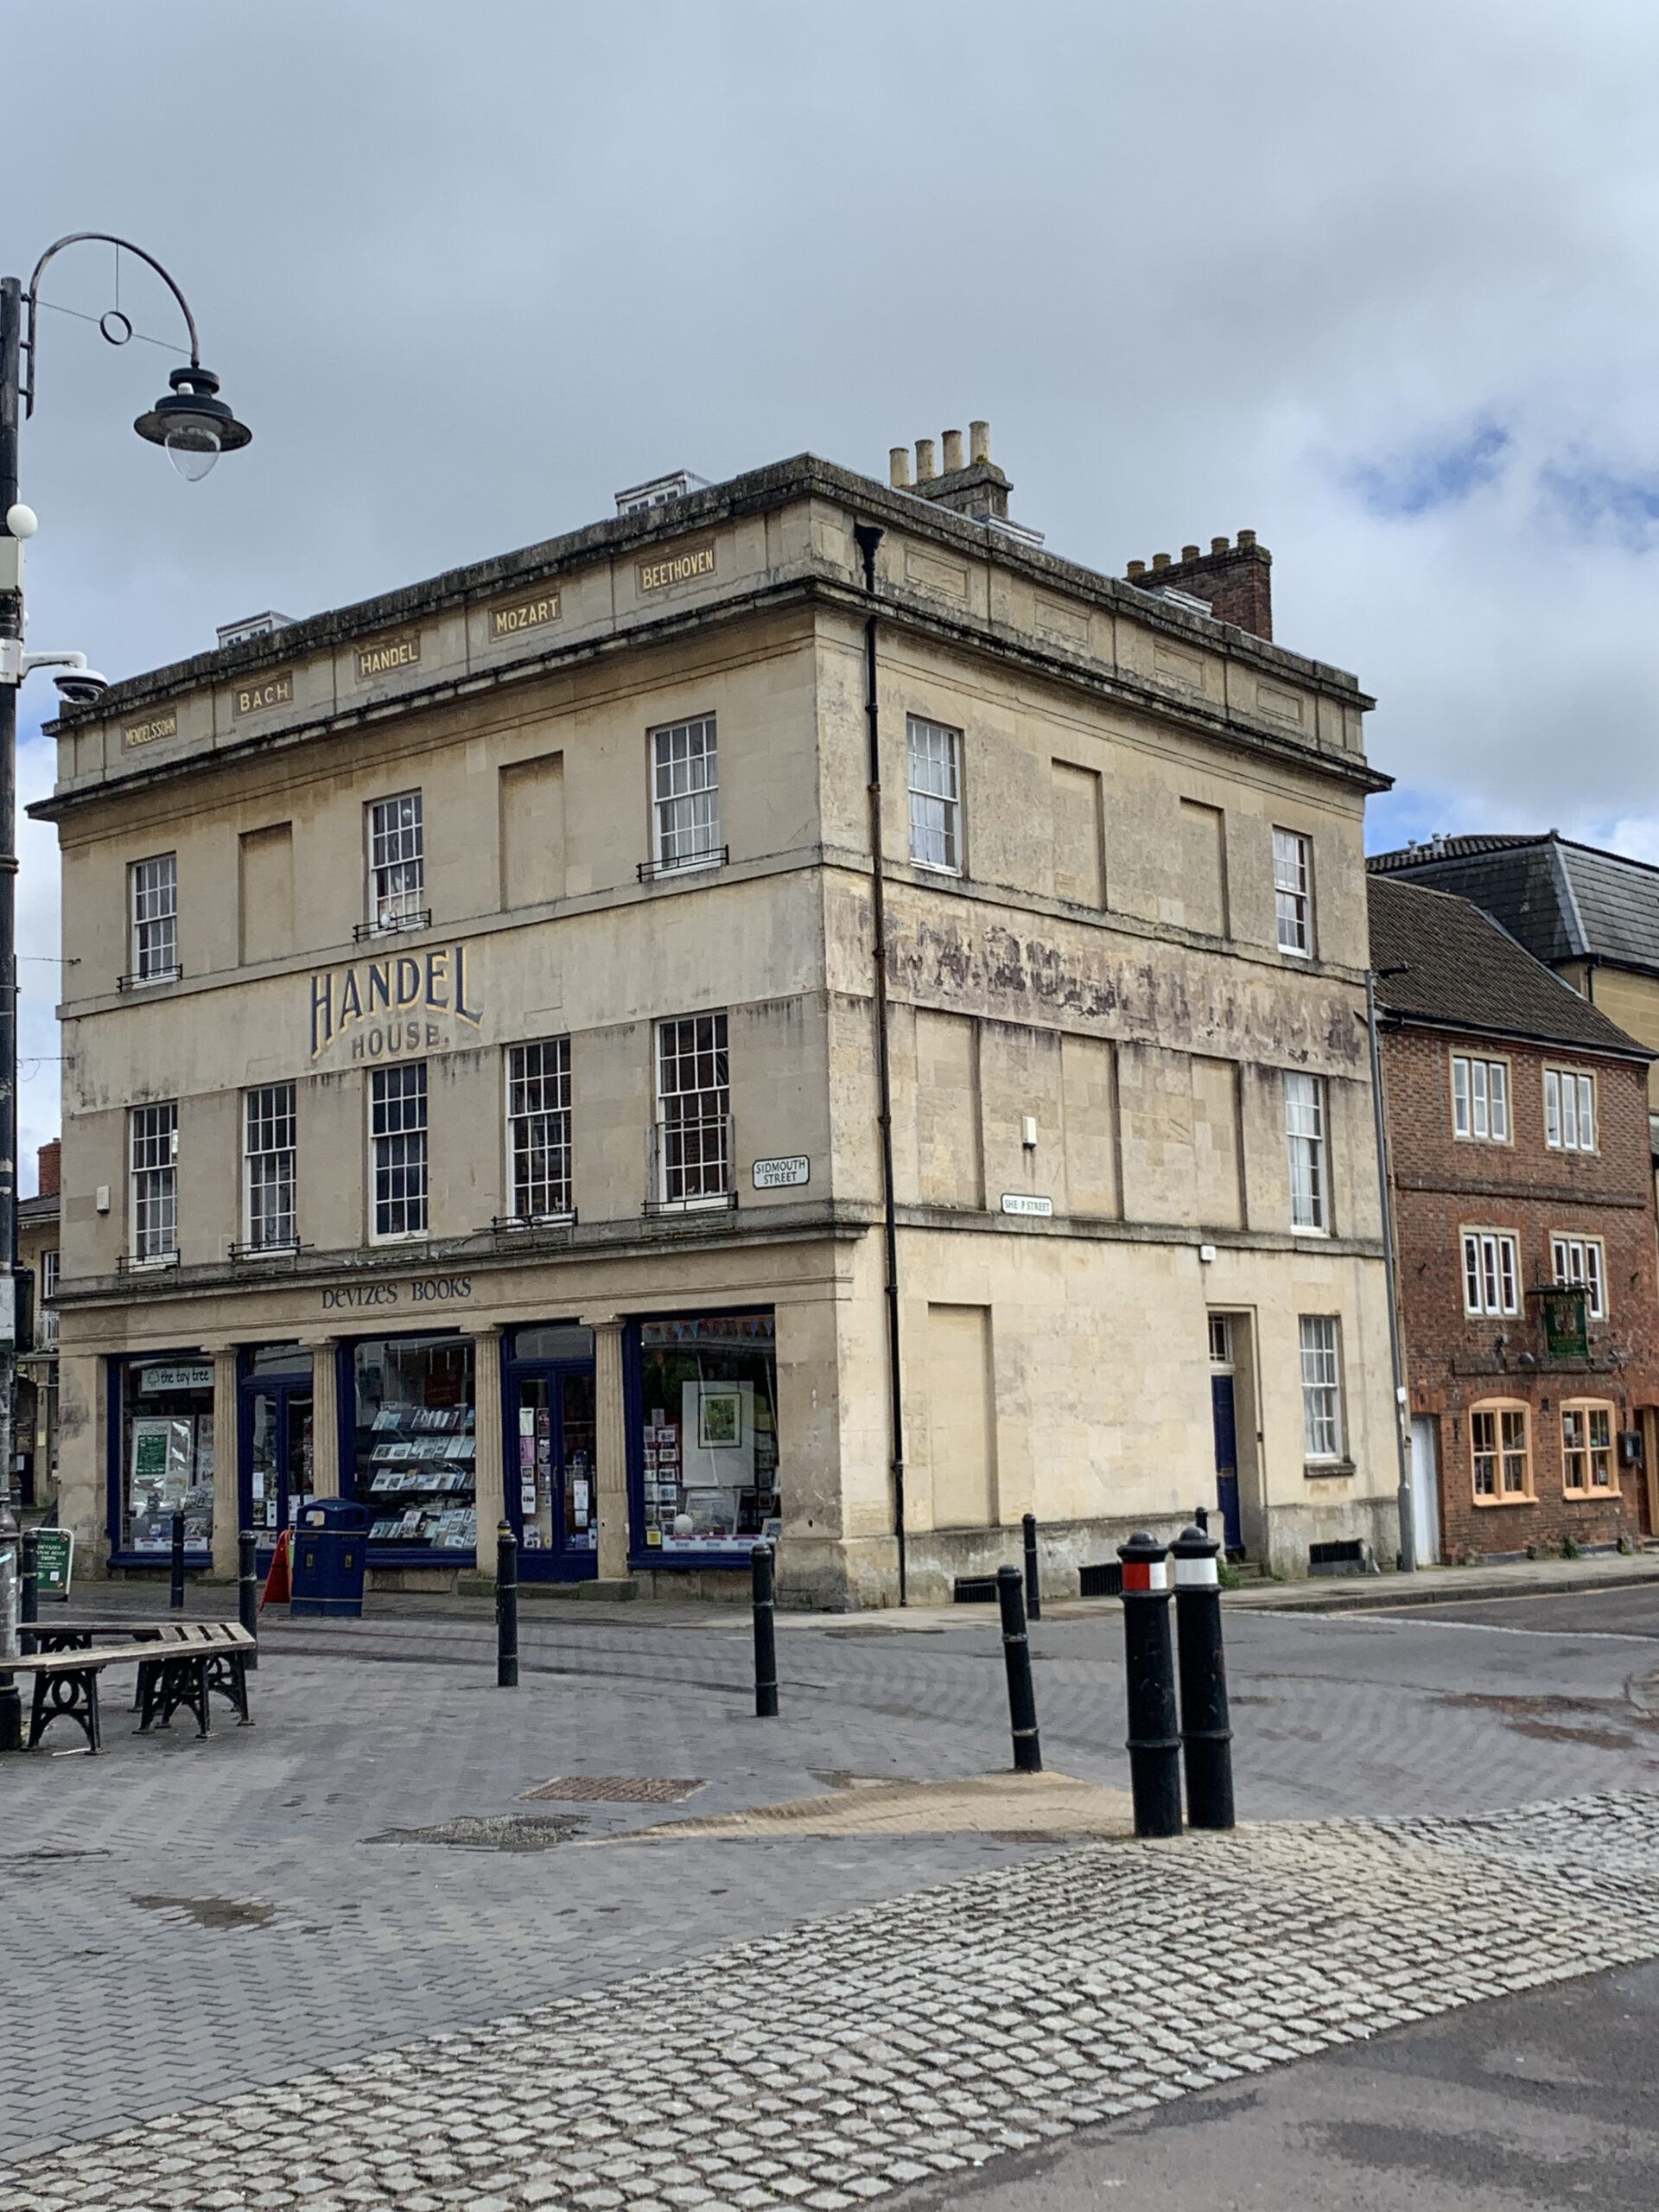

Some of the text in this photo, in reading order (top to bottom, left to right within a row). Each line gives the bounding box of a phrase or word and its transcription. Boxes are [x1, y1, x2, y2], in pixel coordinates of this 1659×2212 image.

[642, 550, 714, 589] BEETHOVEN
[496, 598, 558, 633] MOZART
[361, 643, 418, 675] HANDEL
[239, 683, 289, 712] BACH
[125, 716, 175, 747] MENDELSSOHN
[311, 946, 484, 1060] HANDEL
[756, 1159, 805, 1174] SIDMOUTH
[764, 1171, 797, 1185] STREET
[1027, 1201, 1050, 1212] STREET
[411, 1276, 472, 1301] BOOKS
[161, 1367, 209, 1386] the toy tree
